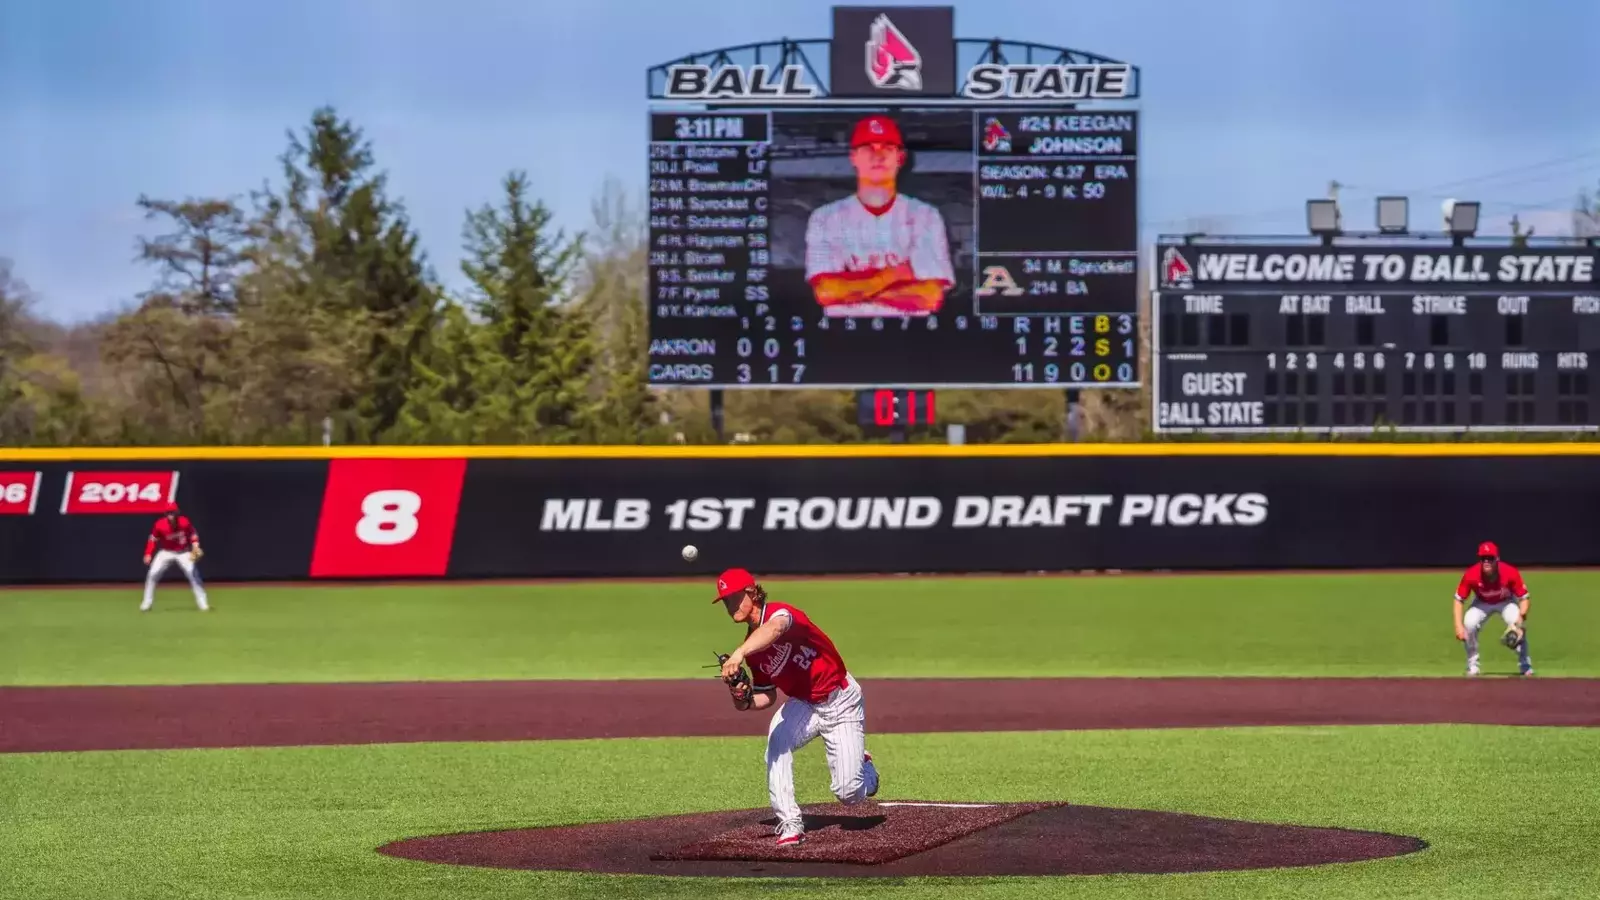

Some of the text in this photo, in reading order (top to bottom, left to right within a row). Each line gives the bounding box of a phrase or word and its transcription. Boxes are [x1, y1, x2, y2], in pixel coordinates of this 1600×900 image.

[665, 64, 1130, 98] BALL STATE
[675, 117, 744, 138] 3:11 PM
[1018, 115, 1132, 131] #24 KEEGAN
[1028, 136, 1123, 154] JOHNSON
[748, 160, 767, 173] LF
[1094, 165, 1129, 180] ERA
[1016, 184, 1028, 198] 4
[1083, 182, 1105, 199] 50
[754, 196, 768, 211] C
[747, 214, 768, 229] 2B
[749, 249, 769, 264] 1B
[1197, 254, 1594, 282] WELCOME TO BALL STATE
[744, 285, 769, 300] SS
[1066, 280, 1089, 295] BA
[755, 303, 769, 316] P
[1183, 295, 1224, 314] TIME
[1279, 295, 1332, 314] AT BAT
[1345, 295, 1386, 314] BALL
[1412, 295, 1468, 315] STRIKE
[1497, 296, 1530, 315] OUT
[742, 317, 749, 330] 1
[764, 316, 776, 330] 2
[791, 316, 804, 331] 3
[818, 316, 829, 329] 4
[845, 316, 856, 330] 5
[872, 316, 884, 330] 6
[901, 316, 911, 330] 7
[926, 315, 938, 330] 8
[955, 316, 968, 330] 9
[1013, 316, 1030, 334] R
[1044, 316, 1060, 334] H
[1070, 316, 1085, 334] E
[1094, 315, 1110, 333] B
[1117, 314, 1132, 334] 3
[648, 336, 1133, 358] AKRON 0 0 1 1 2 2 S 1
[1267, 352, 1588, 370] 1 2 3 4 5 6 7 8 9 10 RUNS HITS
[648, 364, 714, 381] CARDS
[737, 363, 752, 383] 3
[767, 364, 779, 383] 1
[791, 364, 806, 383] 7
[1012, 362, 1034, 381] 11
[1044, 363, 1059, 382] 9
[1070, 362, 1086, 382] 0
[1117, 363, 1132, 382] 0
[1182, 372, 1247, 396] GUEST
[874, 388, 936, 426] 0:11
[1207, 401, 1264, 425] STATE
[0, 482, 27, 504] 6
[78, 482, 161, 503] 2014
[355, 489, 422, 546] 8
[539, 492, 1269, 531] MLB 1ST ROUND DRAFT PICKS
[792, 645, 817, 670] 24
